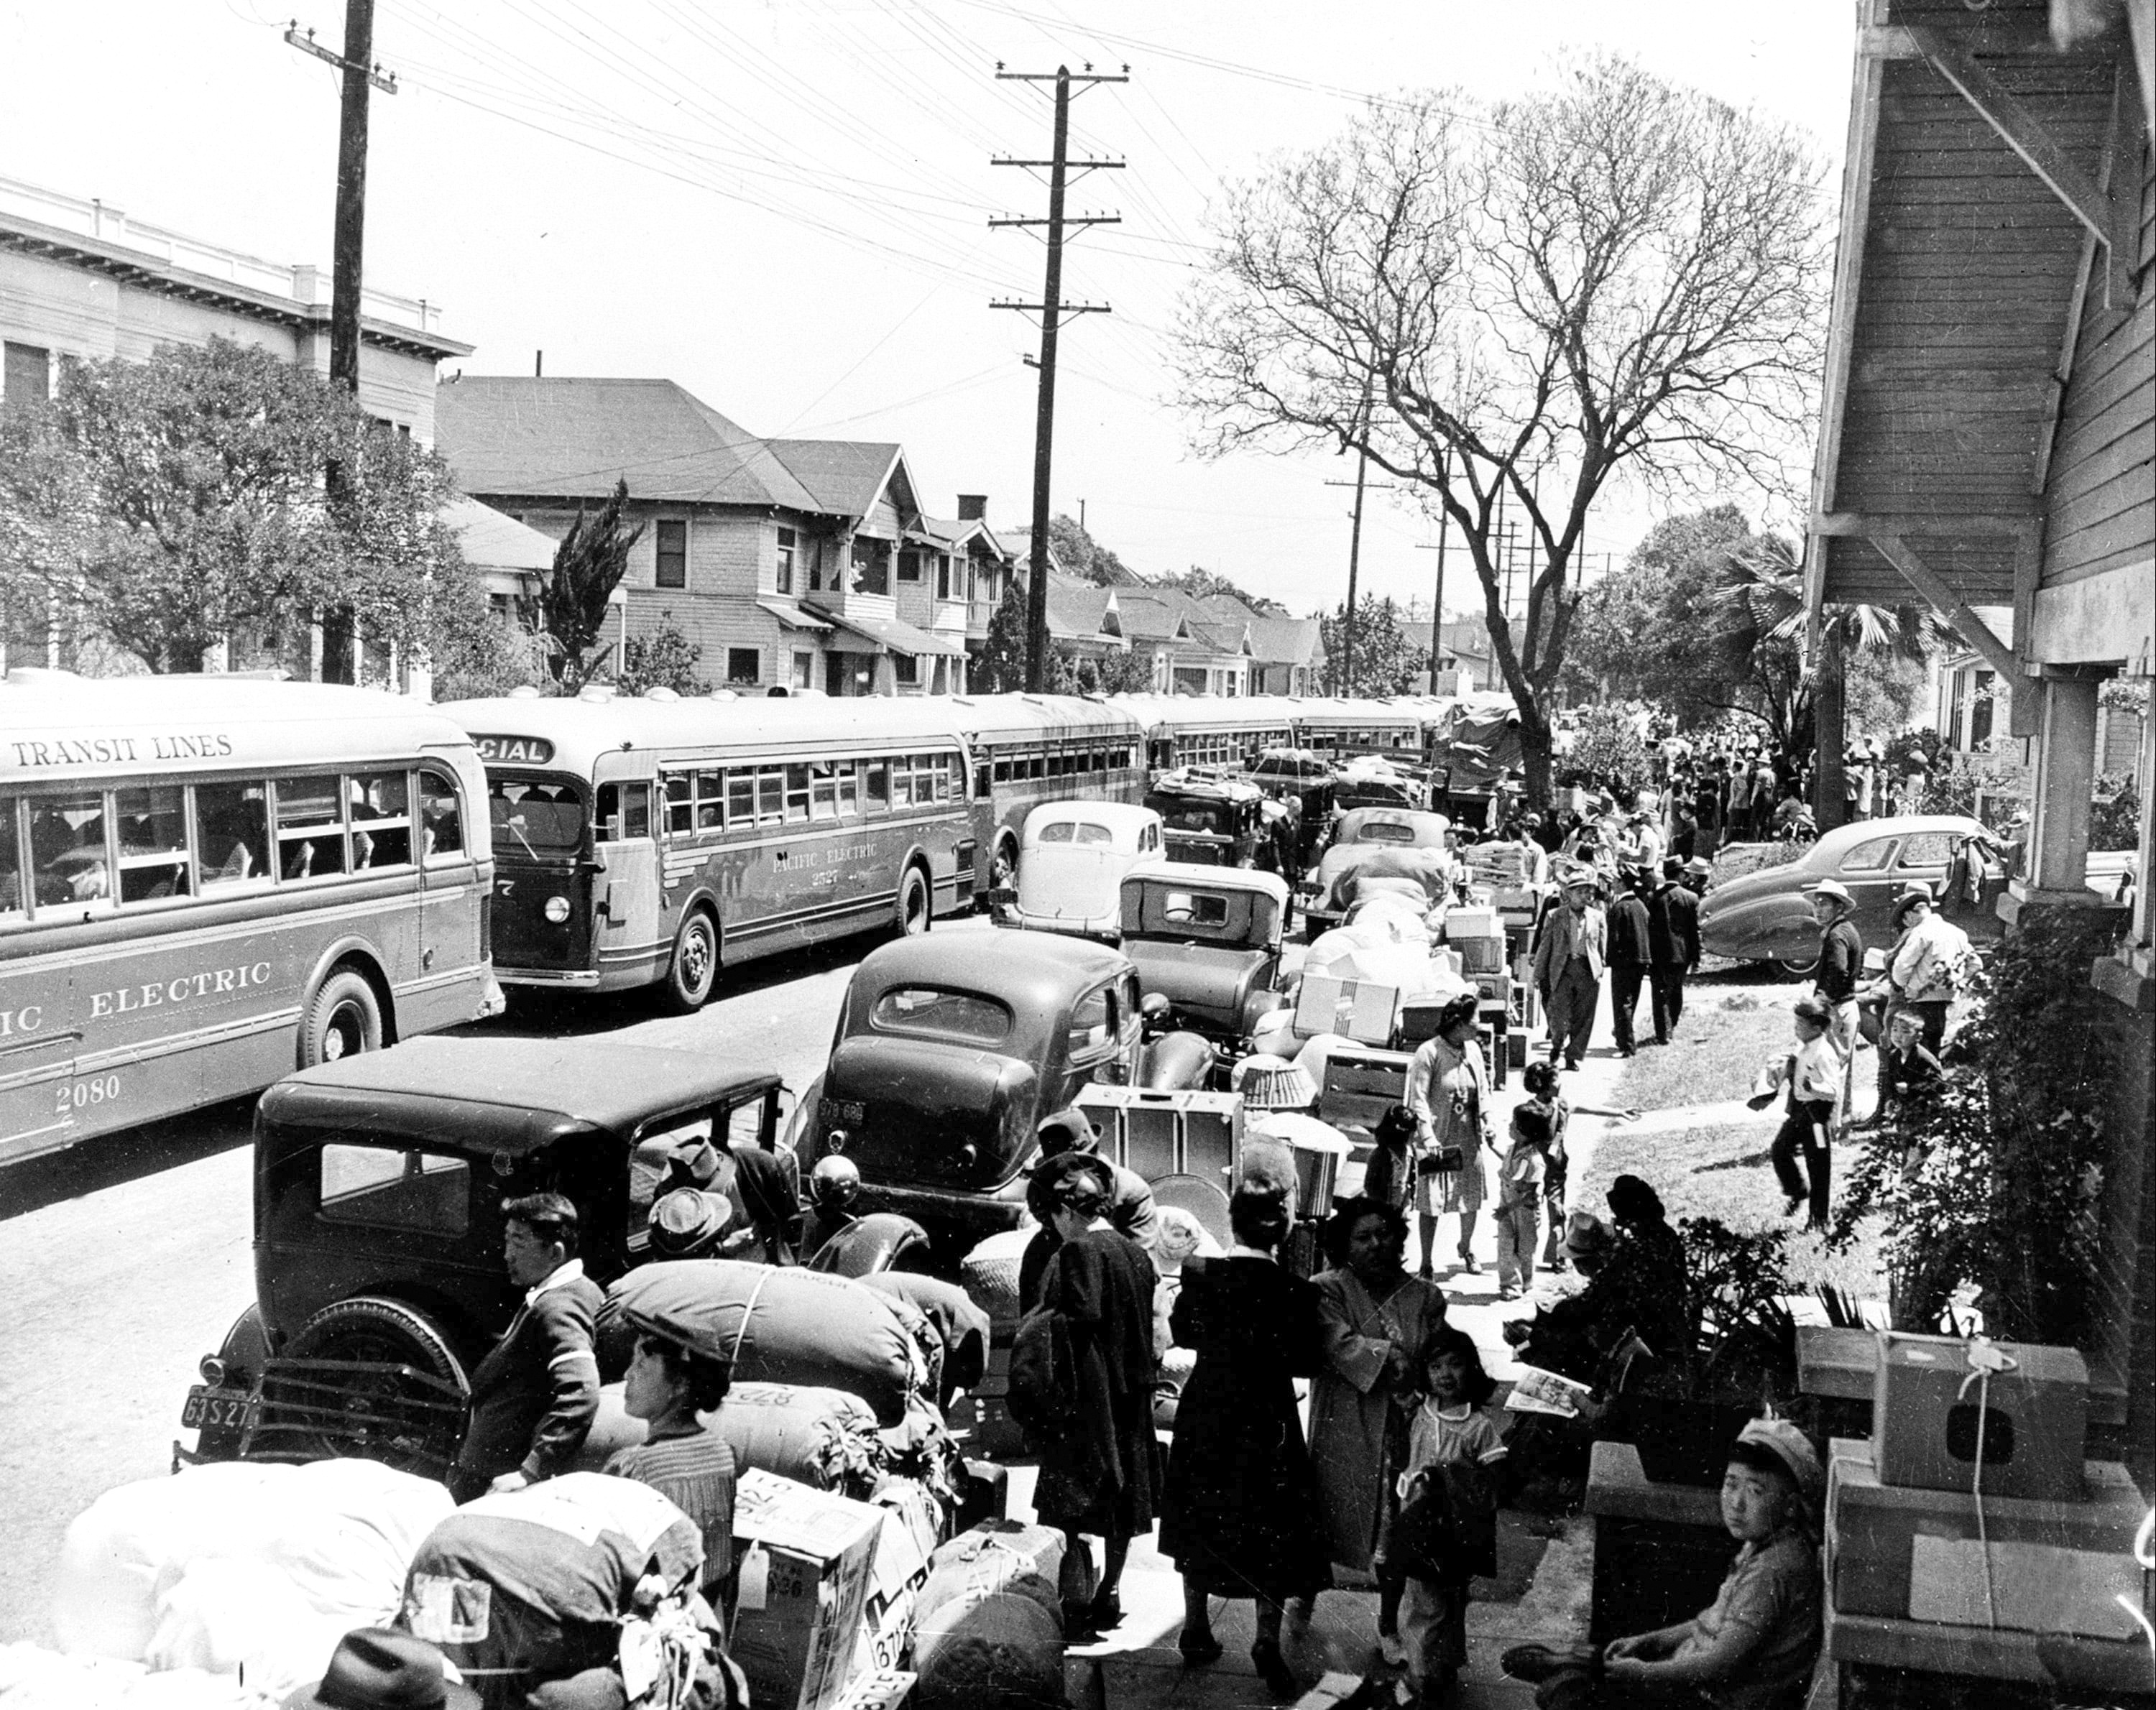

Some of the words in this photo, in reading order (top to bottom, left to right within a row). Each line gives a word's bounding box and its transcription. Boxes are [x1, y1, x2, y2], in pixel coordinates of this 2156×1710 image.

[11, 738, 137, 766] TRANSIT
[152, 734, 232, 759] LINES
[474, 737, 543, 761] CIAL
[773, 852, 817, 873] PACIFIC
[826, 843, 877, 864] ELECTRIC
[812, 869, 839, 886] 2527
[90, 961, 271, 1018] ELECTRIC
[55, 1075, 120, 1112] 2080
